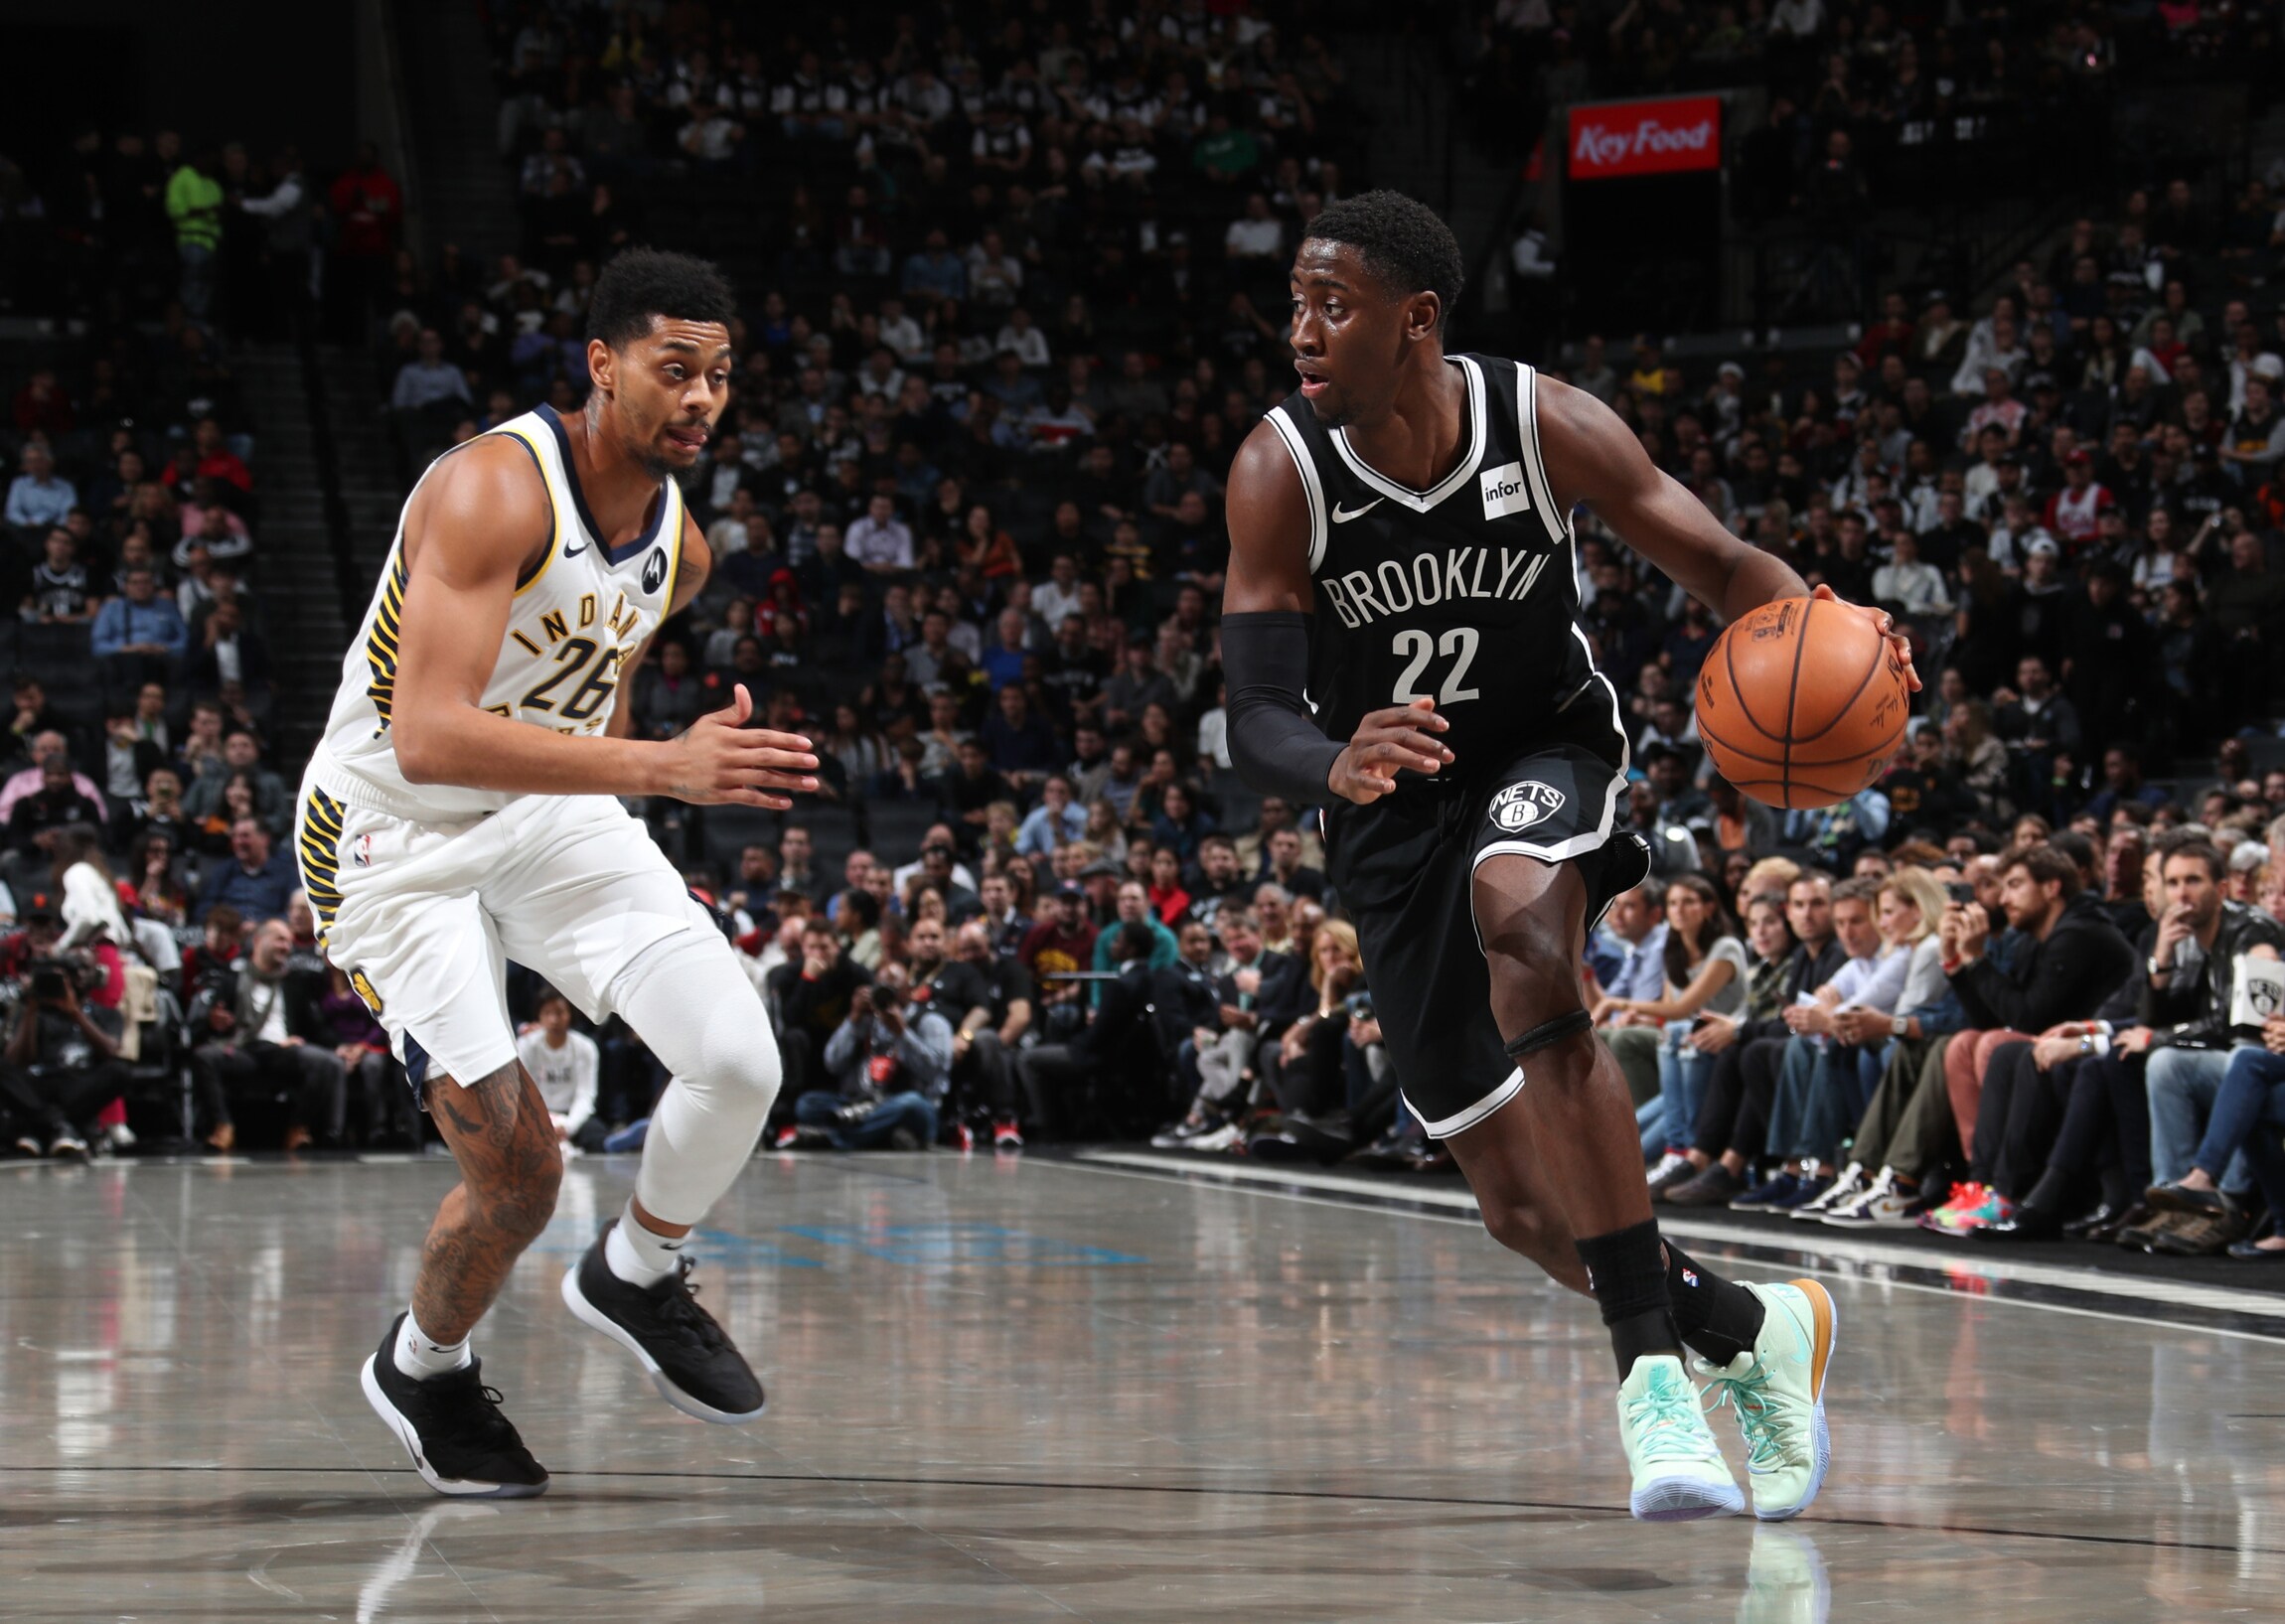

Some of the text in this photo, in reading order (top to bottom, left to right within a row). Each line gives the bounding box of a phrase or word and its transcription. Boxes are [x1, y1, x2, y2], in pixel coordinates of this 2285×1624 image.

[1632, 118, 1712, 156] Food
[1484, 480, 1522, 503] infor
[1321, 546, 1551, 629] BROOKLYN
[509, 589, 640, 668] INDANA
[518, 635, 619, 720] 26
[1392, 627, 1480, 706] 22
[1491, 783, 1560, 812] NETS
[1511, 804, 1526, 823] B
